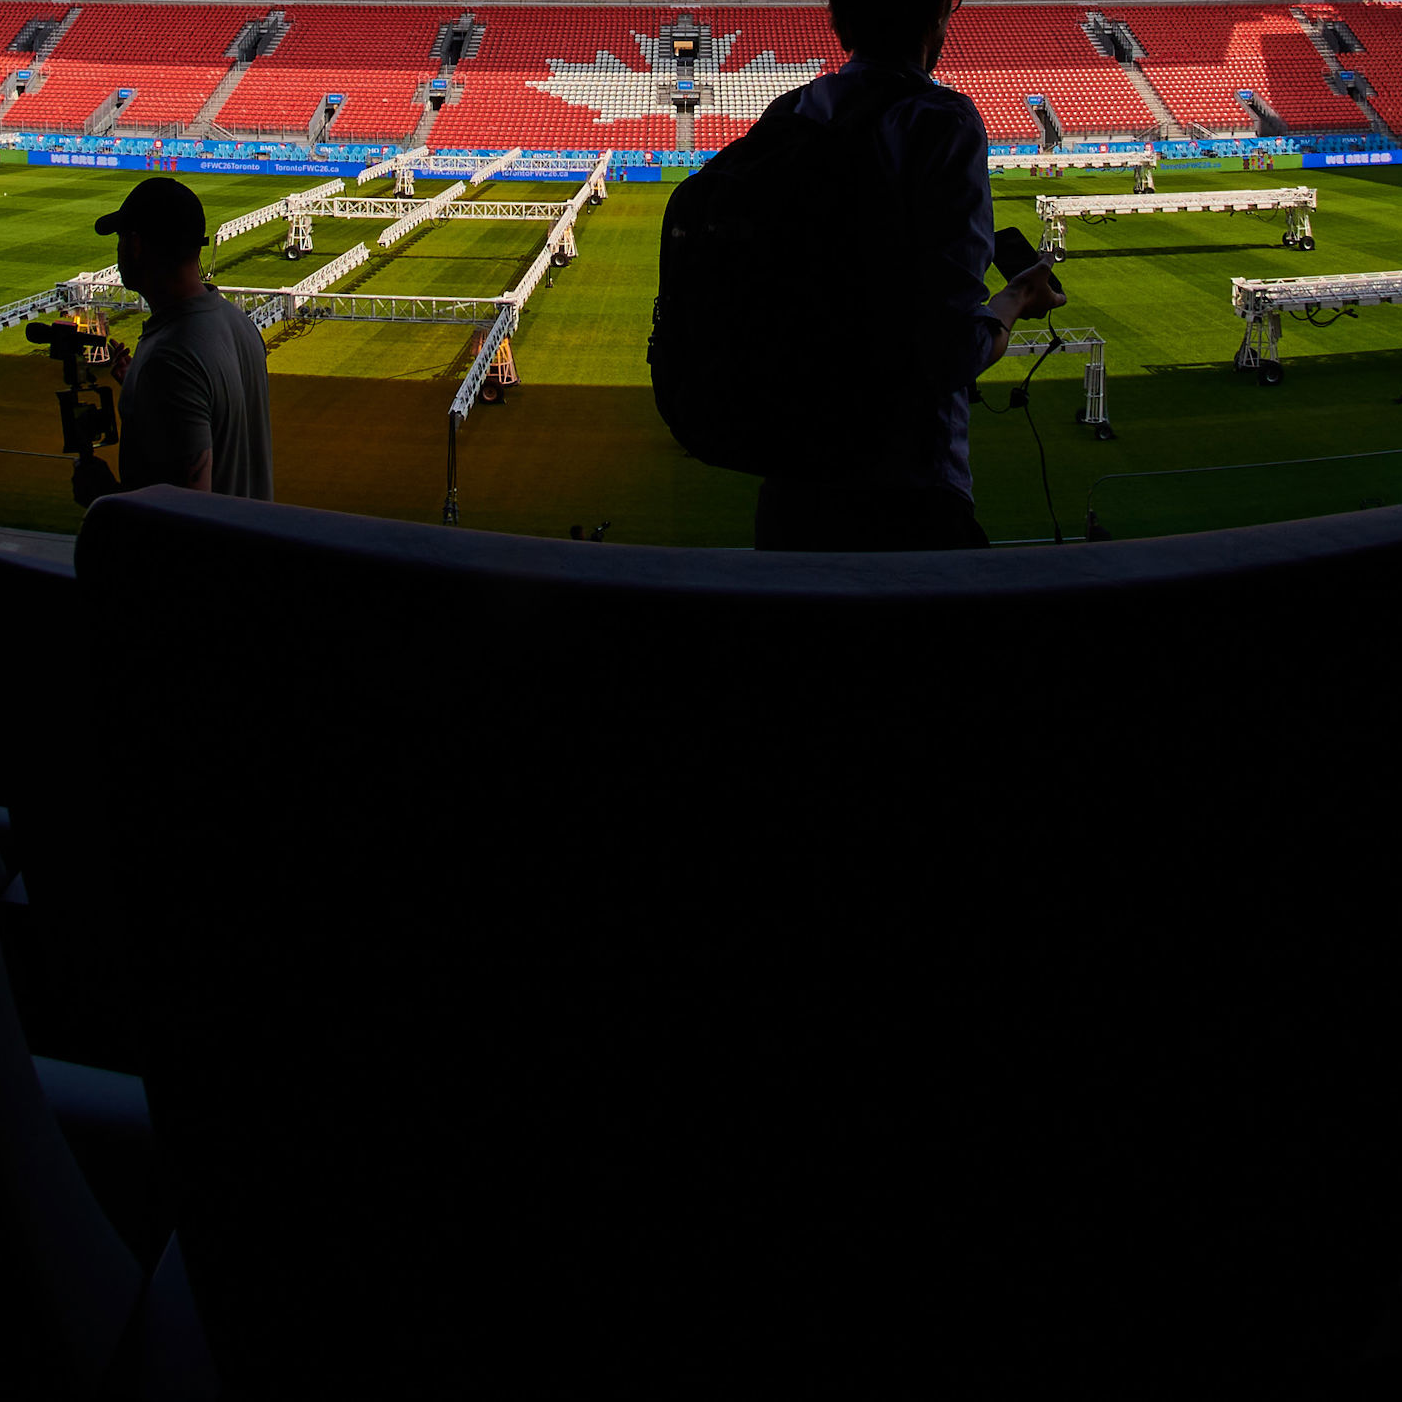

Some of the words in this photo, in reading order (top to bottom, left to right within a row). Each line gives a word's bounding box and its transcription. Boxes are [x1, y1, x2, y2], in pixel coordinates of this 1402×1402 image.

[1325, 154, 1344, 165] WE
[200, 161, 260, 171] @FWC26Toronto
[275, 163, 340, 173] TorontoFWC26.ca
